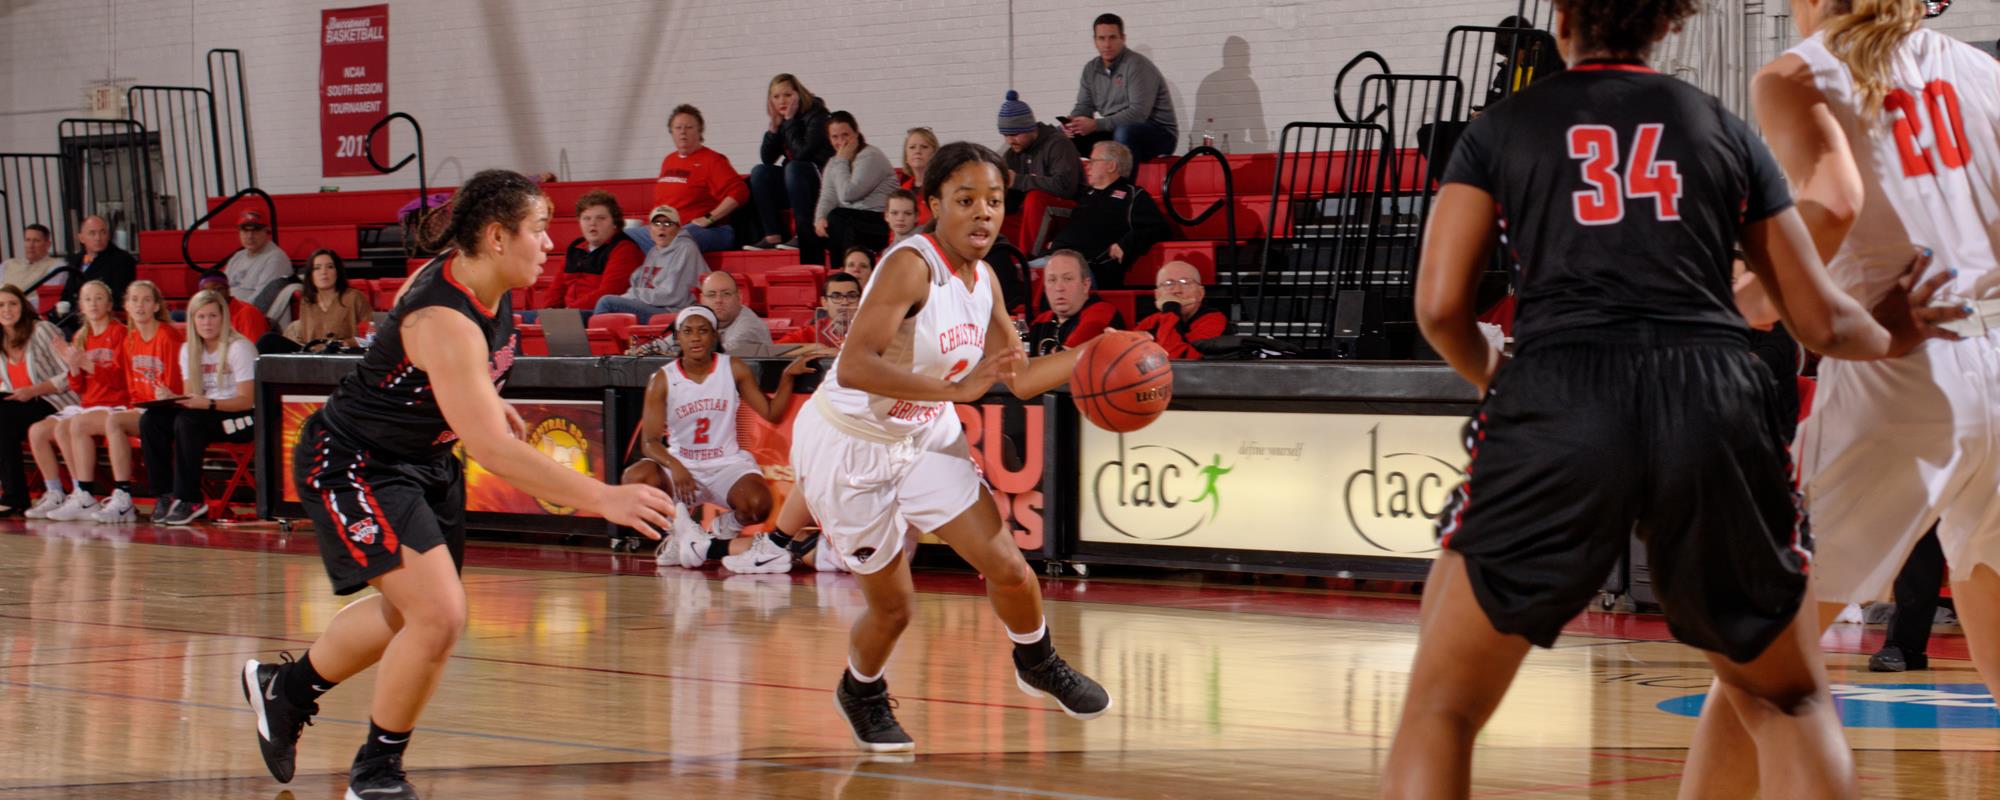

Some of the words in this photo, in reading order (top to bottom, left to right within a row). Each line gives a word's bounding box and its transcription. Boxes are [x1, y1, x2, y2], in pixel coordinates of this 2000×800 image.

[326, 26, 385, 44] BASKETBALL
[343, 66, 366, 79] NCAA
[327, 84, 353, 97] SOUTH
[353, 82, 384, 95] REGION
[328, 101, 382, 114] TOURNAMENT
[1883, 78, 1973, 178] 20
[1567, 123, 1682, 226] 34
[675, 398, 728, 419] CHRISTIAN
[693, 417, 711, 444] 2
[679, 446, 724, 461] BROTHERS
[1093, 432, 1186, 515] dac
